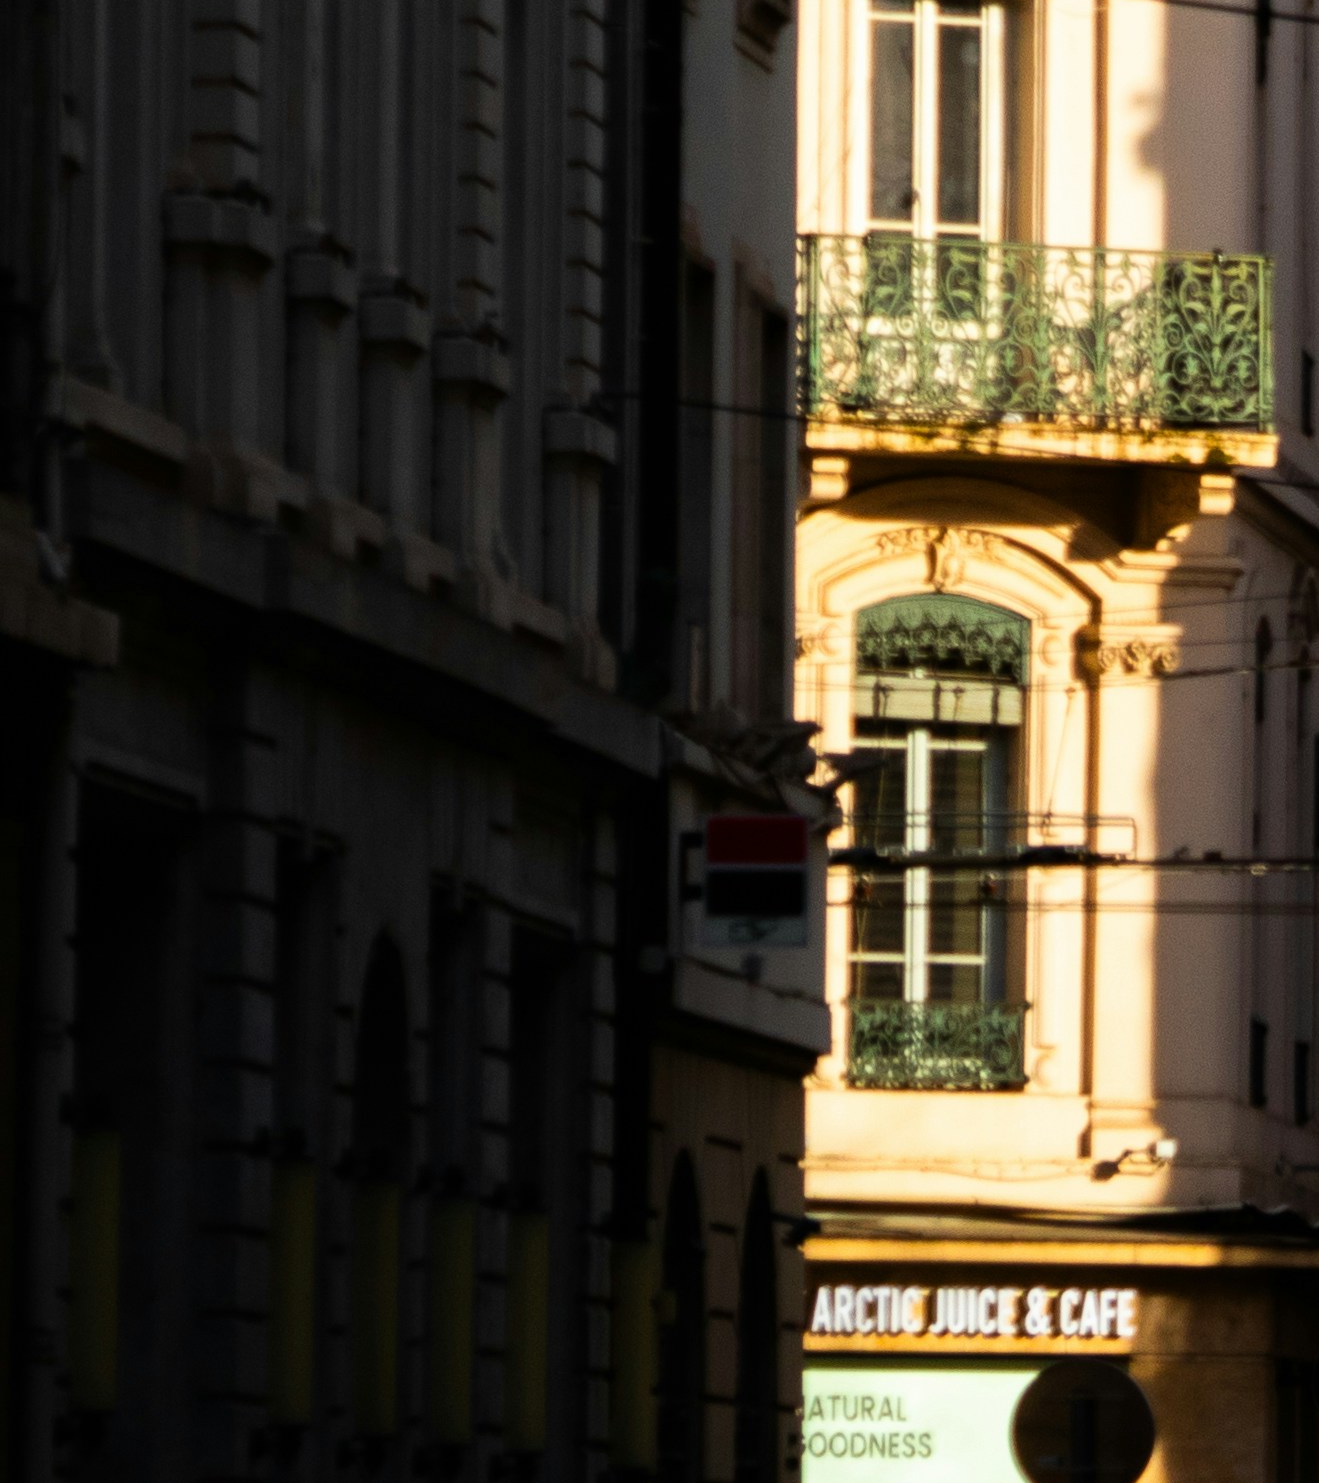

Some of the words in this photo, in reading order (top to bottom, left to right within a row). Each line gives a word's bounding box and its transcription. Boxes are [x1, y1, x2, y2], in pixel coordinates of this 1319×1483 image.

[811, 1285, 926, 1335] ARCTIC
[928, 1286, 1018, 1336] JUICE
[1023, 1286, 1053, 1337] &
[1059, 1287, 1139, 1338] CAFE
